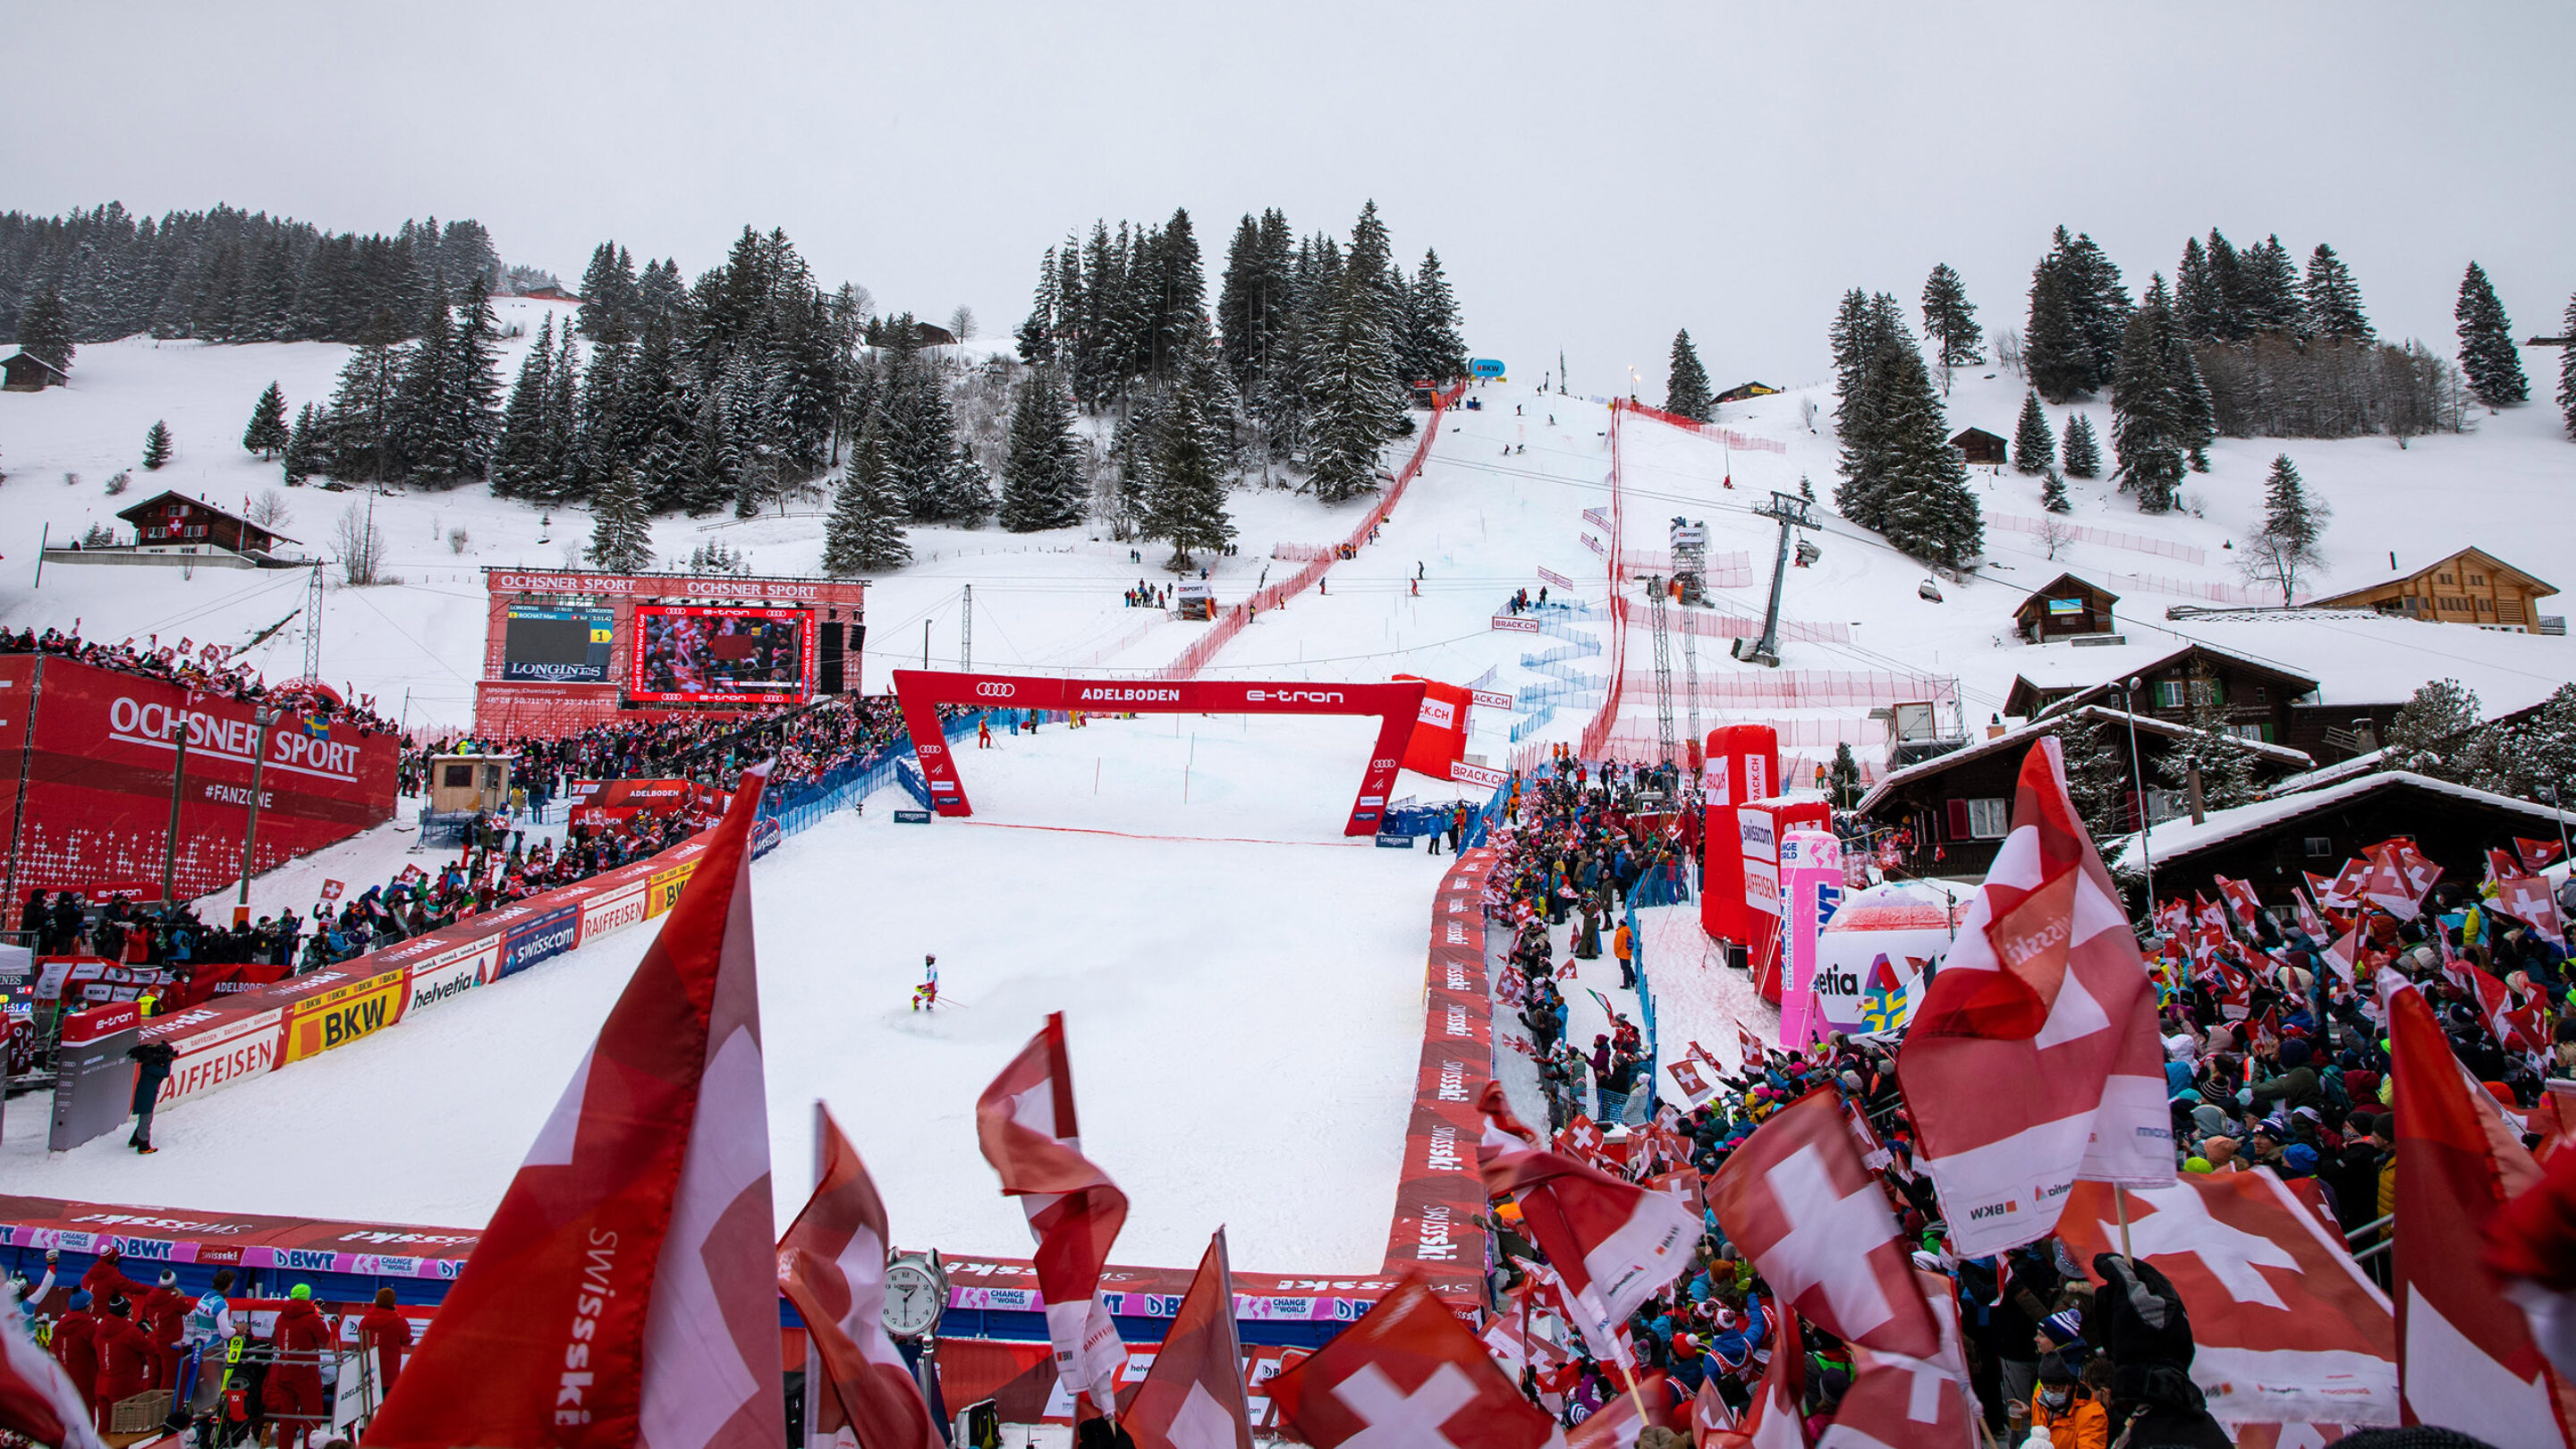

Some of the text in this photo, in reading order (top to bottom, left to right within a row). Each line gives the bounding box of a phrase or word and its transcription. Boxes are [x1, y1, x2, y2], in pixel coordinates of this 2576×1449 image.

[501, 575, 636, 590] OCHSNER SPORT
[688, 581, 818, 597] OCHSNER SPORT
[1496, 620, 1536, 630] BRACK.CH
[597, 631, 604, 641] 1
[511, 662, 601, 677] LONGINES
[1081, 688, 1180, 701] ADELBODEN
[1247, 690, 1343, 704] e-tron
[1473, 694, 1509, 707] ACK.CH
[110, 697, 360, 775] OCHSNER SPORT
[1453, 764, 1506, 785] BRACK.CH
[1751, 758, 1760, 801] RACK.CH
[630, 790, 680, 798] ADELBODEN
[1743, 818, 1775, 846] swisscom
[585, 900, 642, 939] RAIFFEISEN
[517, 926, 574, 963] swisscom
[383, 972, 397, 983] BKW
[358, 980, 373, 992] BKW
[412, 971, 472, 1011] helvetia
[331, 988, 347, 1001] BKW
[306, 997, 321, 1009] BKW
[97, 1012, 133, 1030] e-tron
[253, 1013, 277, 1025] RAIFFEISEN
[326, 995, 387, 1047] BKW
[1447, 1004, 1473, 1038] swissski
[224, 1022, 249, 1036] RAIFFEISEN
[191, 1033, 217, 1046] RAIFFEISEN
[157, 1039, 272, 1104] AIFFEISEN
[1438, 1059, 1470, 1102] swissski
[1428, 1124, 1462, 1171] swissski
[70, 1214, 252, 1235] swissski
[61, 1232, 89, 1241] CHANGE
[1417, 1205, 1457, 1260] swissski
[67, 1239, 89, 1247] WORLD
[127, 1238, 174, 1259] BWT
[201, 1250, 238, 1261] swissski
[289, 1250, 337, 1271] BWT
[381, 1257, 412, 1266] CHANGE
[386, 1264, 412, 1272] WORLD
[990, 1290, 1025, 1298] CHANGE
[997, 1297, 1025, 1305] WORLD
[555, 1227, 618, 1426] swissski
[1131, 1364, 1151, 1373] helv
